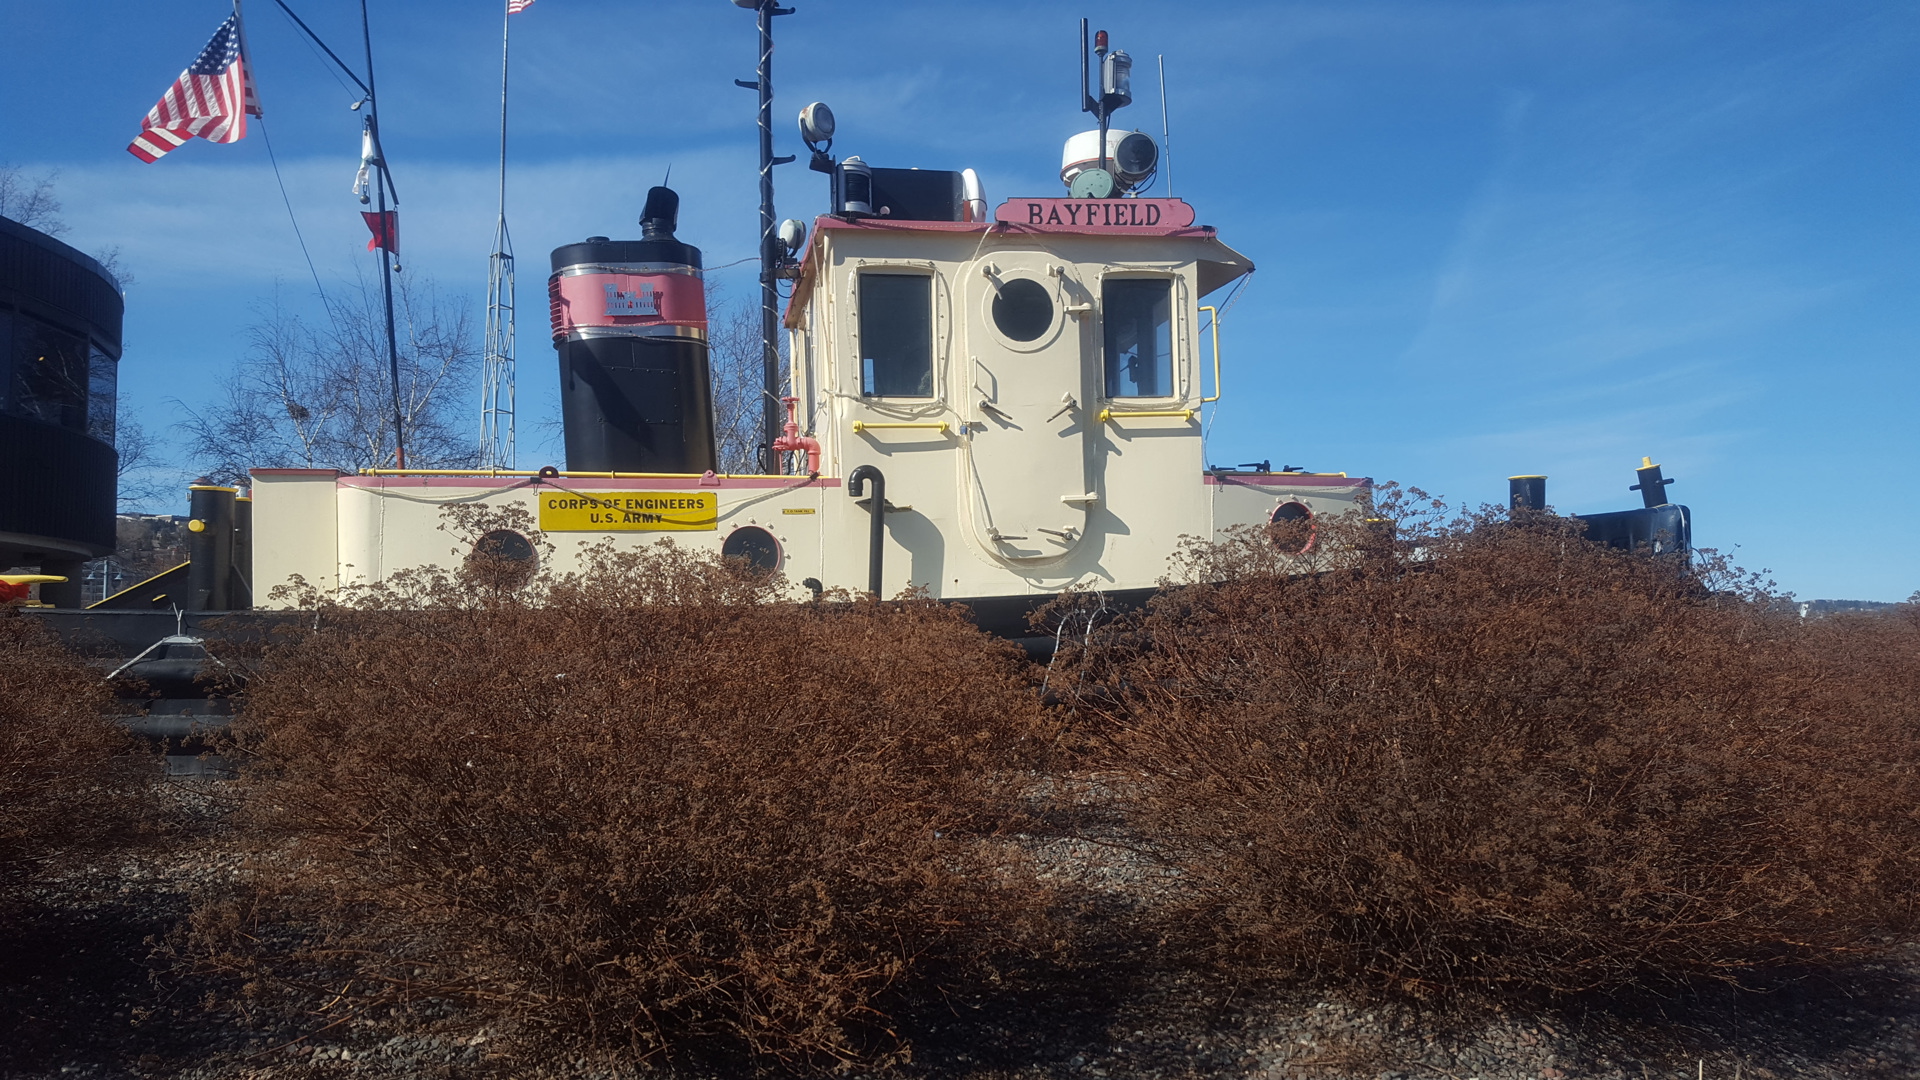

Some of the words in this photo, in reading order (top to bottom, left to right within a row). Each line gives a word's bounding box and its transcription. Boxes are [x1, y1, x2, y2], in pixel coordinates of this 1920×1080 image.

[1027, 203, 1161, 226] BAYFIELD
[548, 498, 598, 510] CORPS
[602, 498, 621, 510] OF
[625, 498, 705, 509] ENGINEERS
[590, 512, 618, 524] U.S.
[622, 512, 663, 524] ARMY
